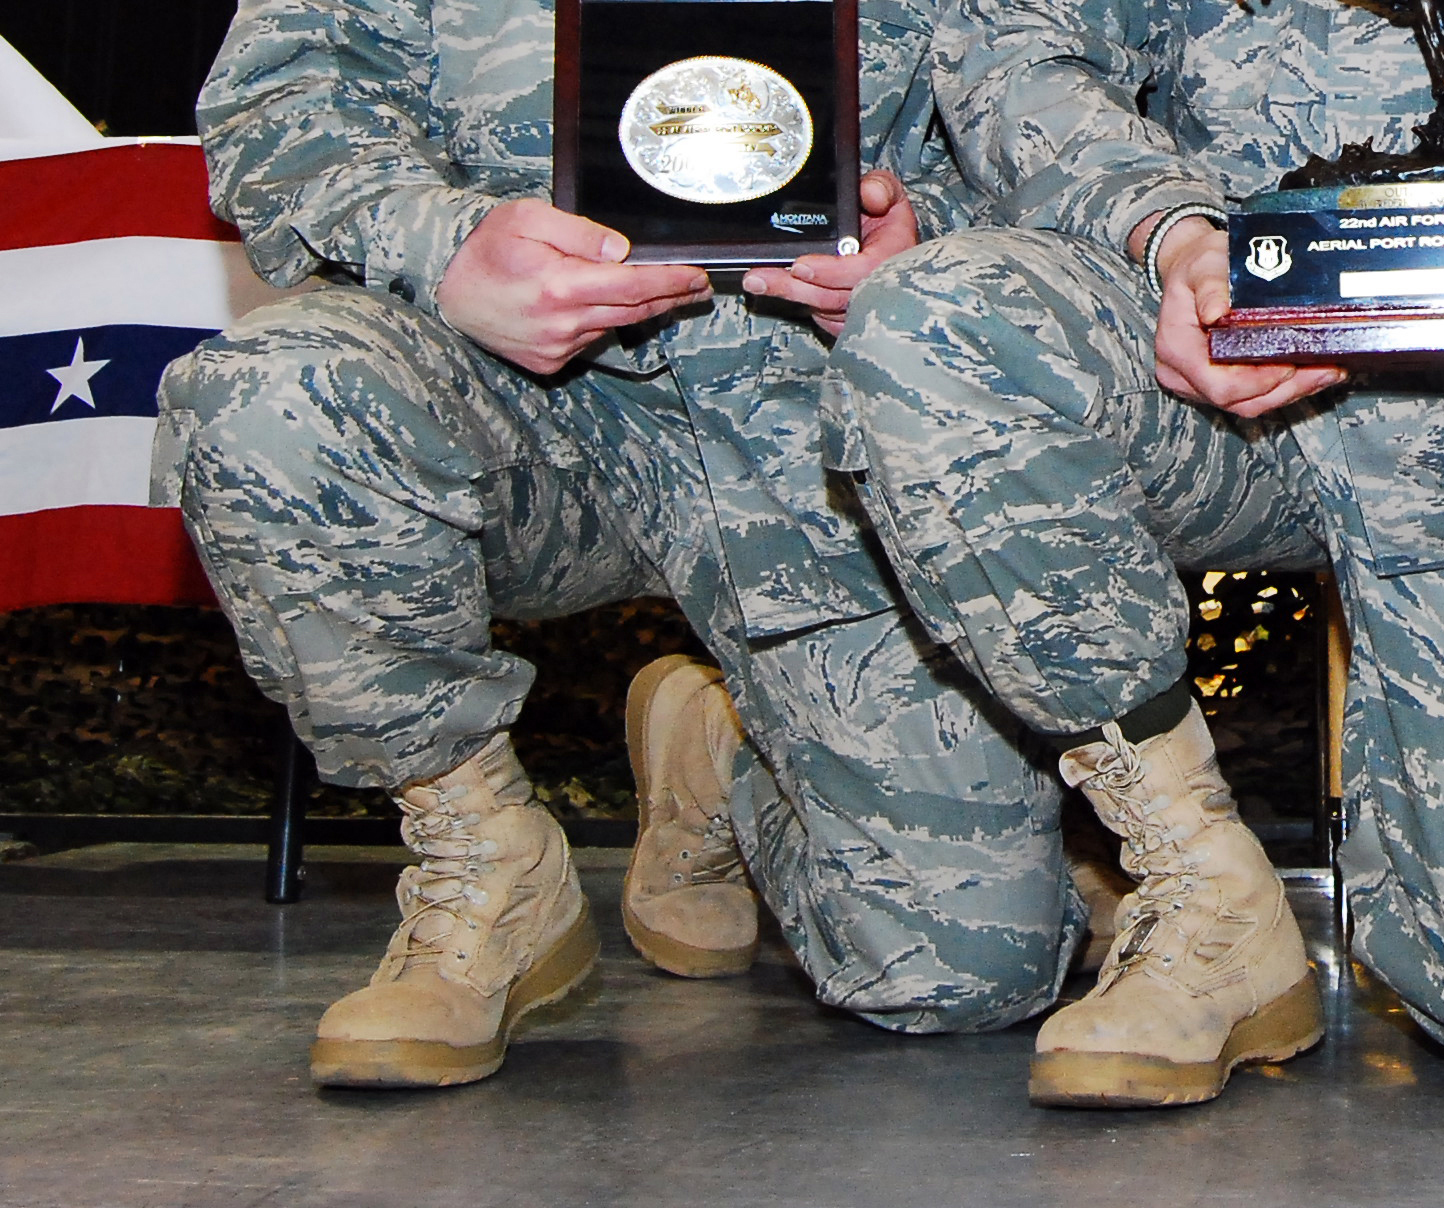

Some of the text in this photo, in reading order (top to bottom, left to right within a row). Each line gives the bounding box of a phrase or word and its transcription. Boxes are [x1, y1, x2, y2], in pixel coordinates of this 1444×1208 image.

[1339, 216, 1377, 229] 22nd
[1378, 215, 1409, 228] AIR
[1307, 238, 1368, 252] AERIAL
[1370, 236, 1417, 250] PORT
